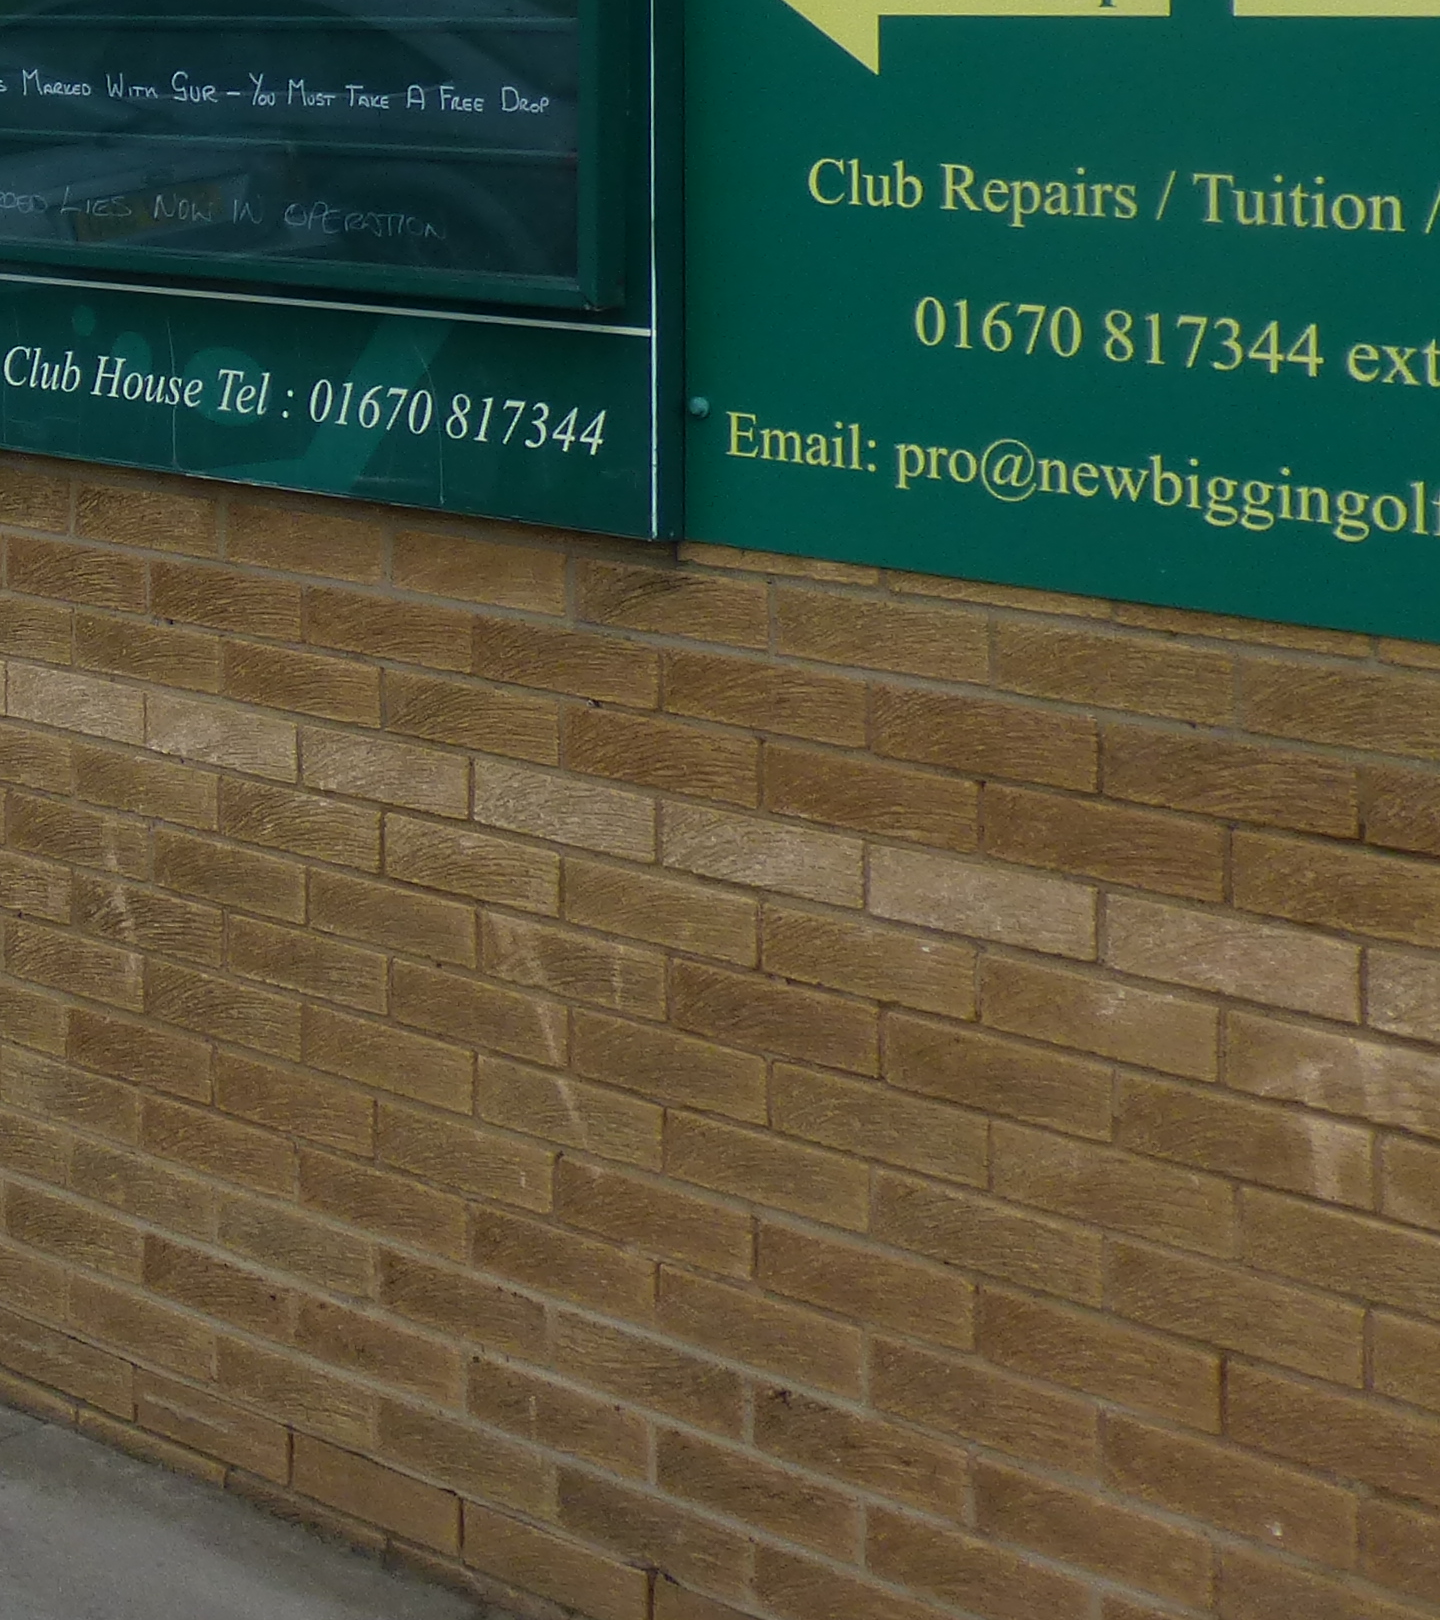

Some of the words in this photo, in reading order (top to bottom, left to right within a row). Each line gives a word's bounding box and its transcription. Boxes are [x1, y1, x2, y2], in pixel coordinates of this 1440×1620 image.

[406, 85, 424, 110] A
[808, 158, 923, 207] Club
[940, 164, 1137, 227] Repairs
[1192, 173, 1405, 232] Tuition
[915, 297, 1082, 355] 01670
[1104, 310, 1323, 376] 817344
[4, 346, 81, 391] Club
[91, 355, 203, 408] House
[218, 369, 268, 416] Tel
[309, 379, 433, 435] 01670
[446, 393, 606, 457] 817344
[726, 411, 876, 471] Email:
